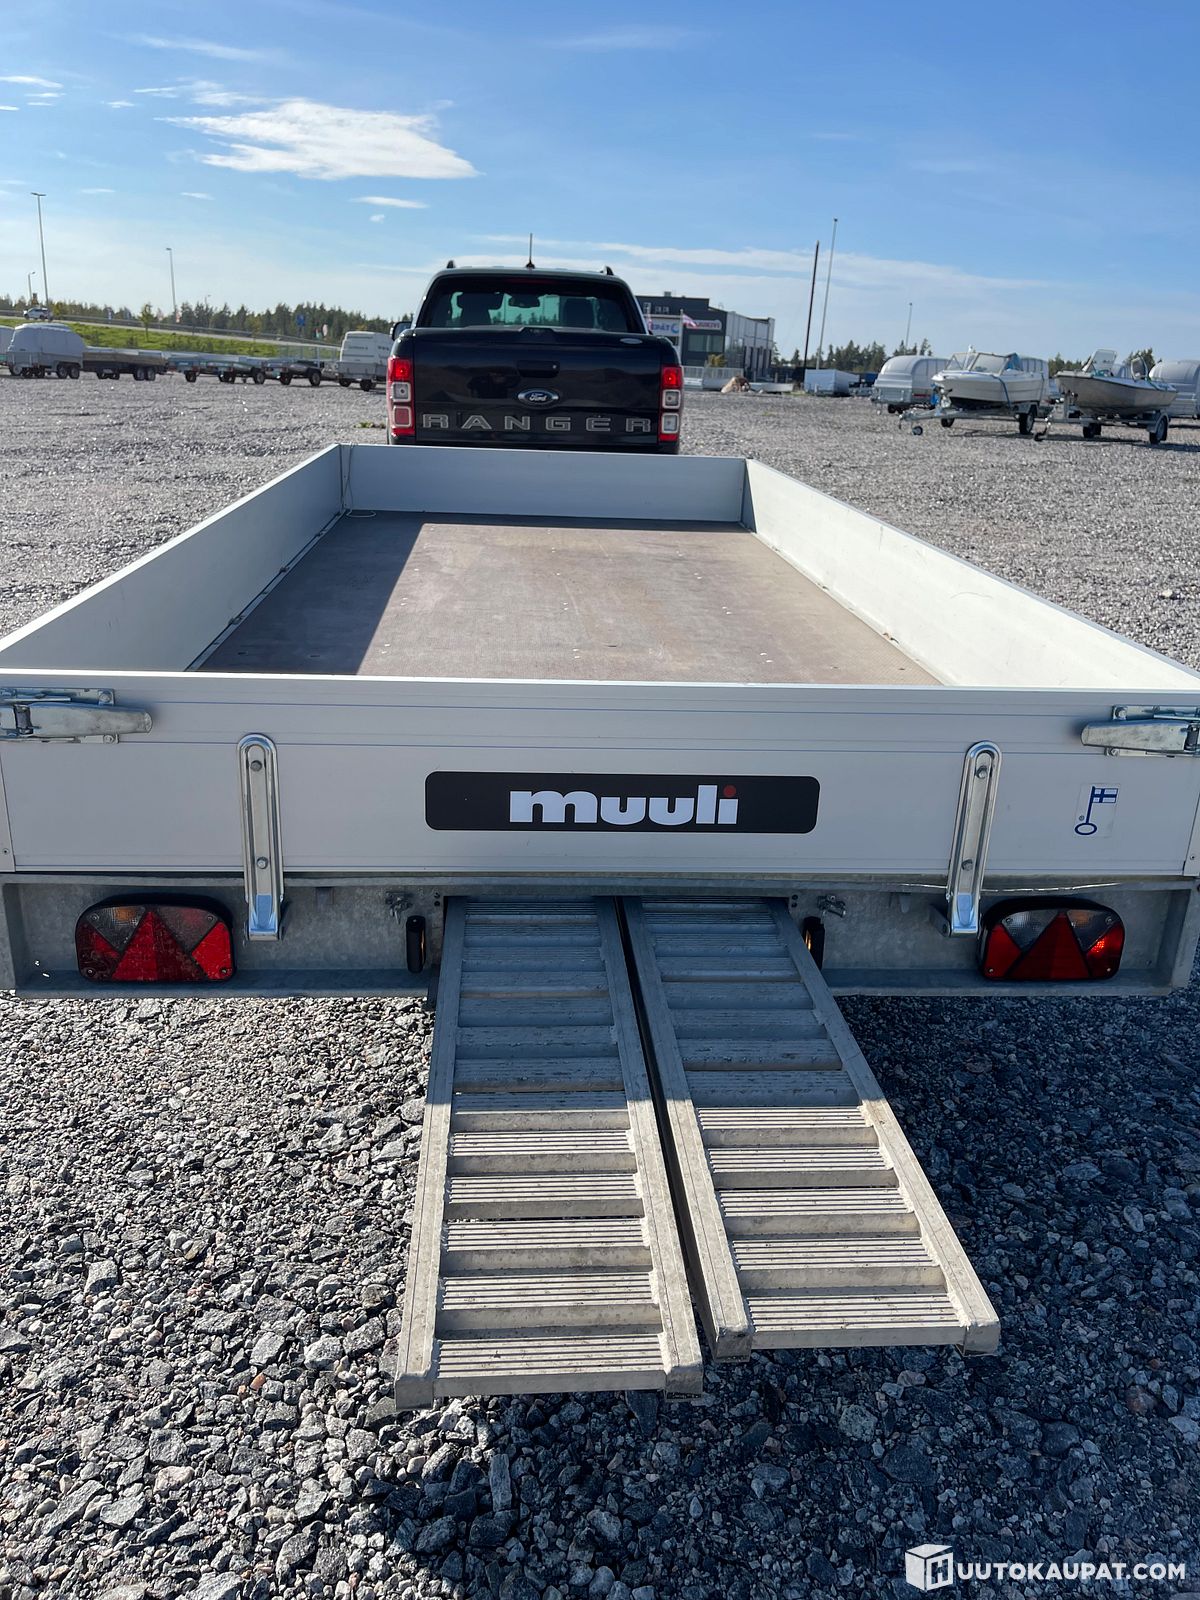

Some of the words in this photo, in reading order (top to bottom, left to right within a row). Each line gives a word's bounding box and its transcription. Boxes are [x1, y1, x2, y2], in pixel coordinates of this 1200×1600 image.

[529, 392, 547, 402] Ford
[422, 413, 651, 433] RANGER
[509, 784, 739, 826] muuli
